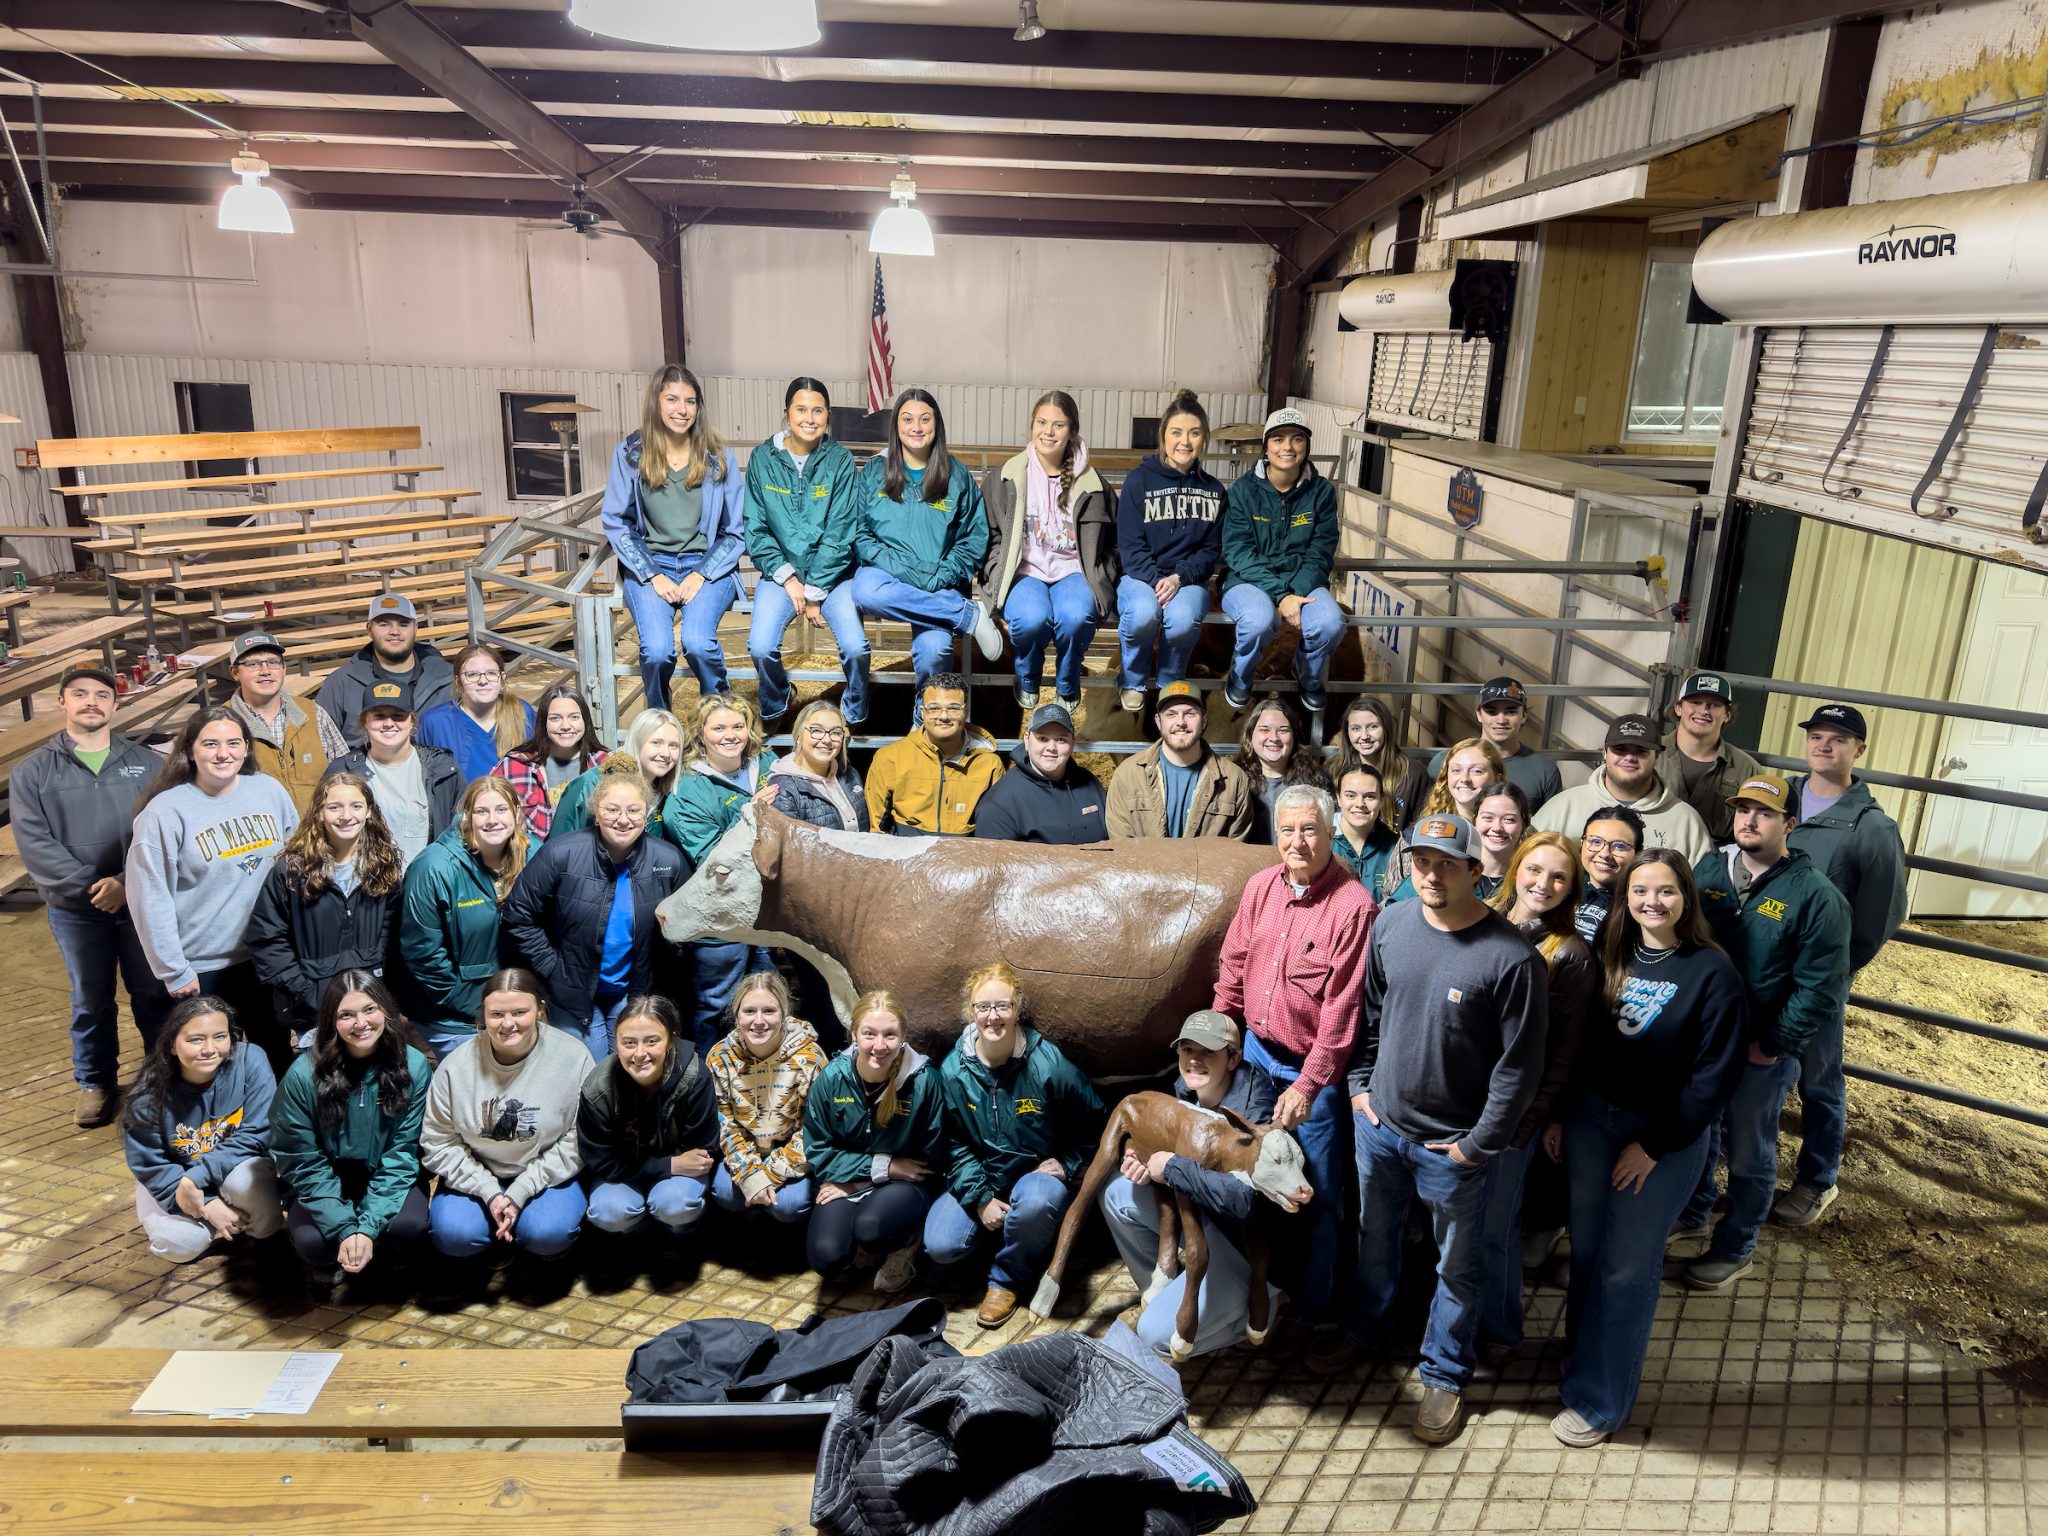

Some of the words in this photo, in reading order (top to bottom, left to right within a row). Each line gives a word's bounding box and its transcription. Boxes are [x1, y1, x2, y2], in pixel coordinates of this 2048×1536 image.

[1858, 233, 1956, 264] RAYNOR
[1375, 293, 1396, 305] RAYNOR
[1153, 487, 1179, 497] UNIVERSIT
[1456, 484, 1475, 504] UTM
[1143, 494, 1220, 523] MARTIN
[1352, 573, 1404, 654] UTM
[194, 826, 224, 863] UT
[1156, 1450, 1187, 1477] Veterinary
[1162, 1448, 1195, 1473] Simulator
[1168, 1443, 1201, 1470] Industries
